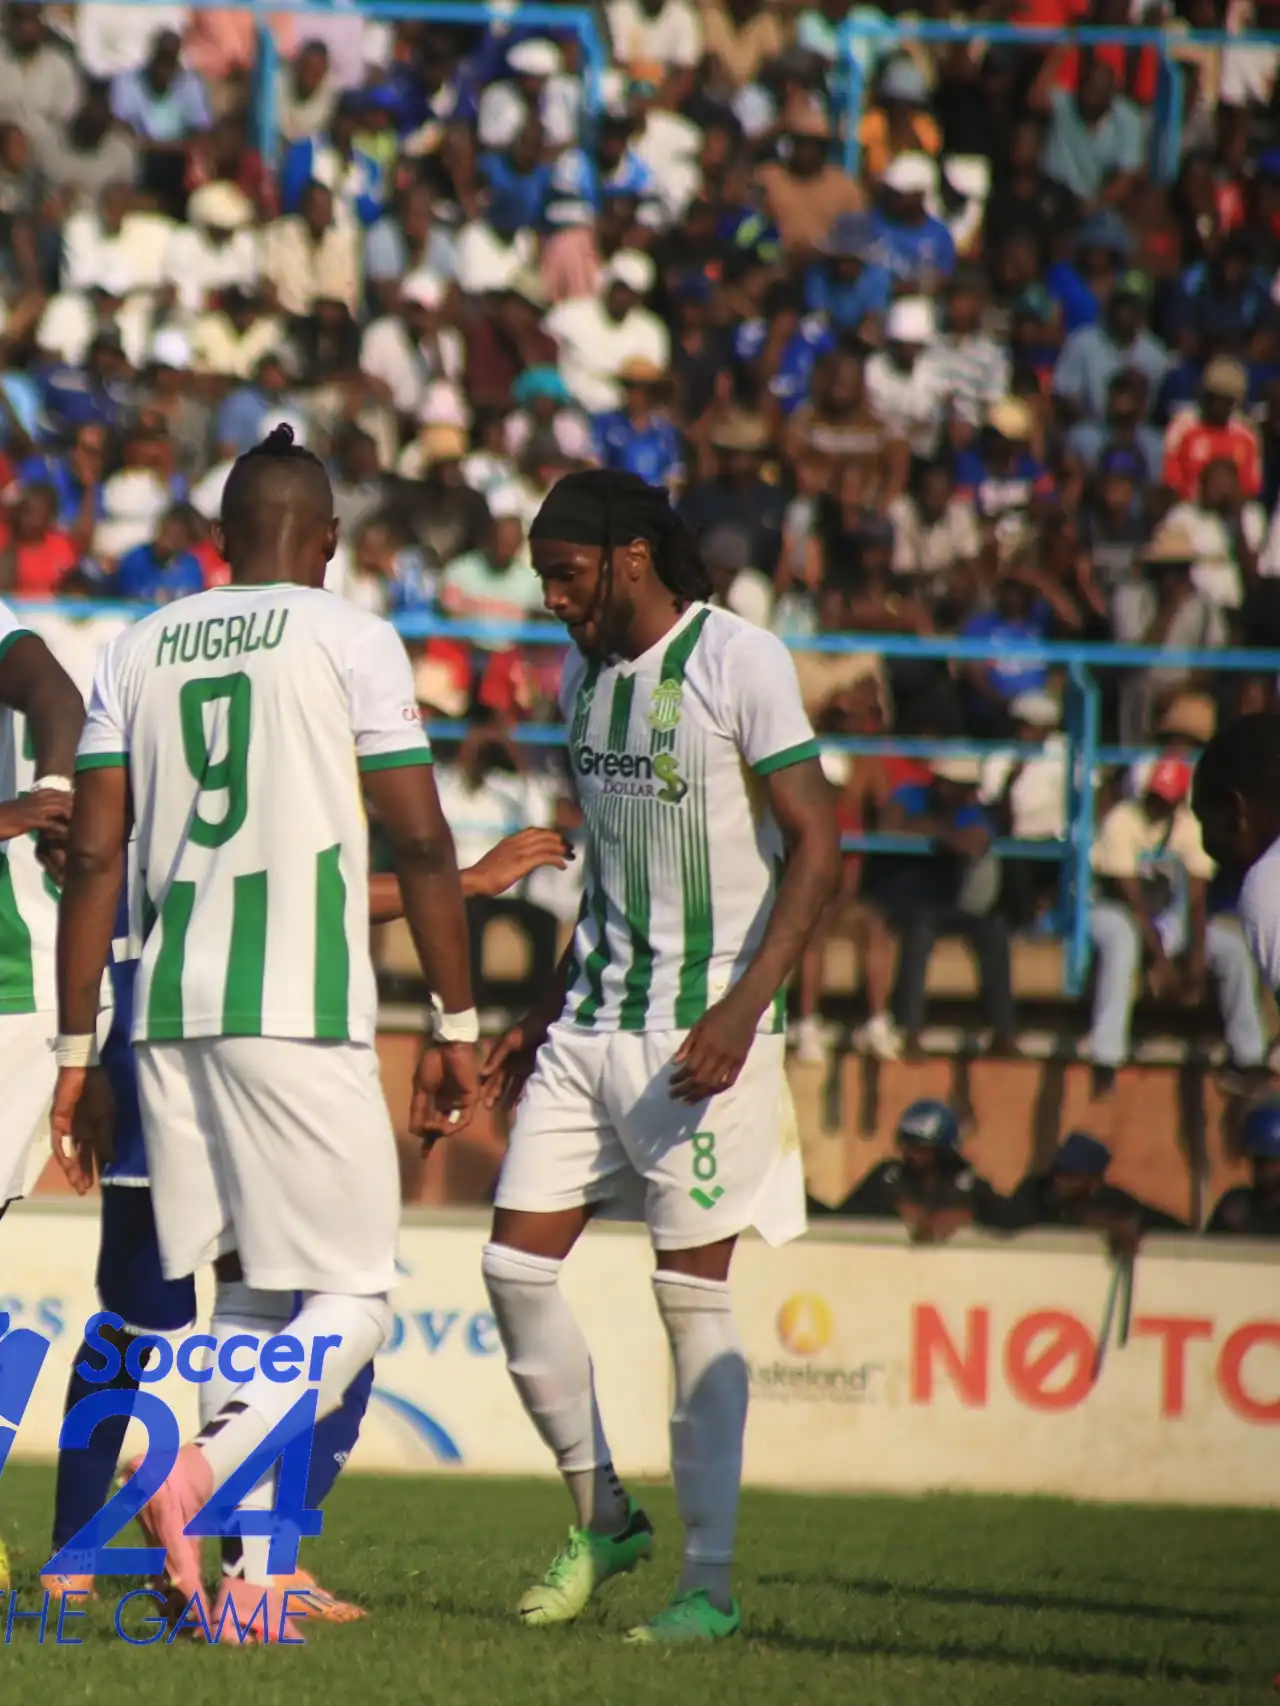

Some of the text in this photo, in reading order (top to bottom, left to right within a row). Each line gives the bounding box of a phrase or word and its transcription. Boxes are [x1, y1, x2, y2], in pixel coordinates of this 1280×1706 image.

[155, 608, 289, 667] MUGALU
[179, 671, 252, 850] 9
[579, 745, 653, 779] Green
[601, 779, 656, 798] DOLLAR
[692, 1132, 718, 1182] 8
